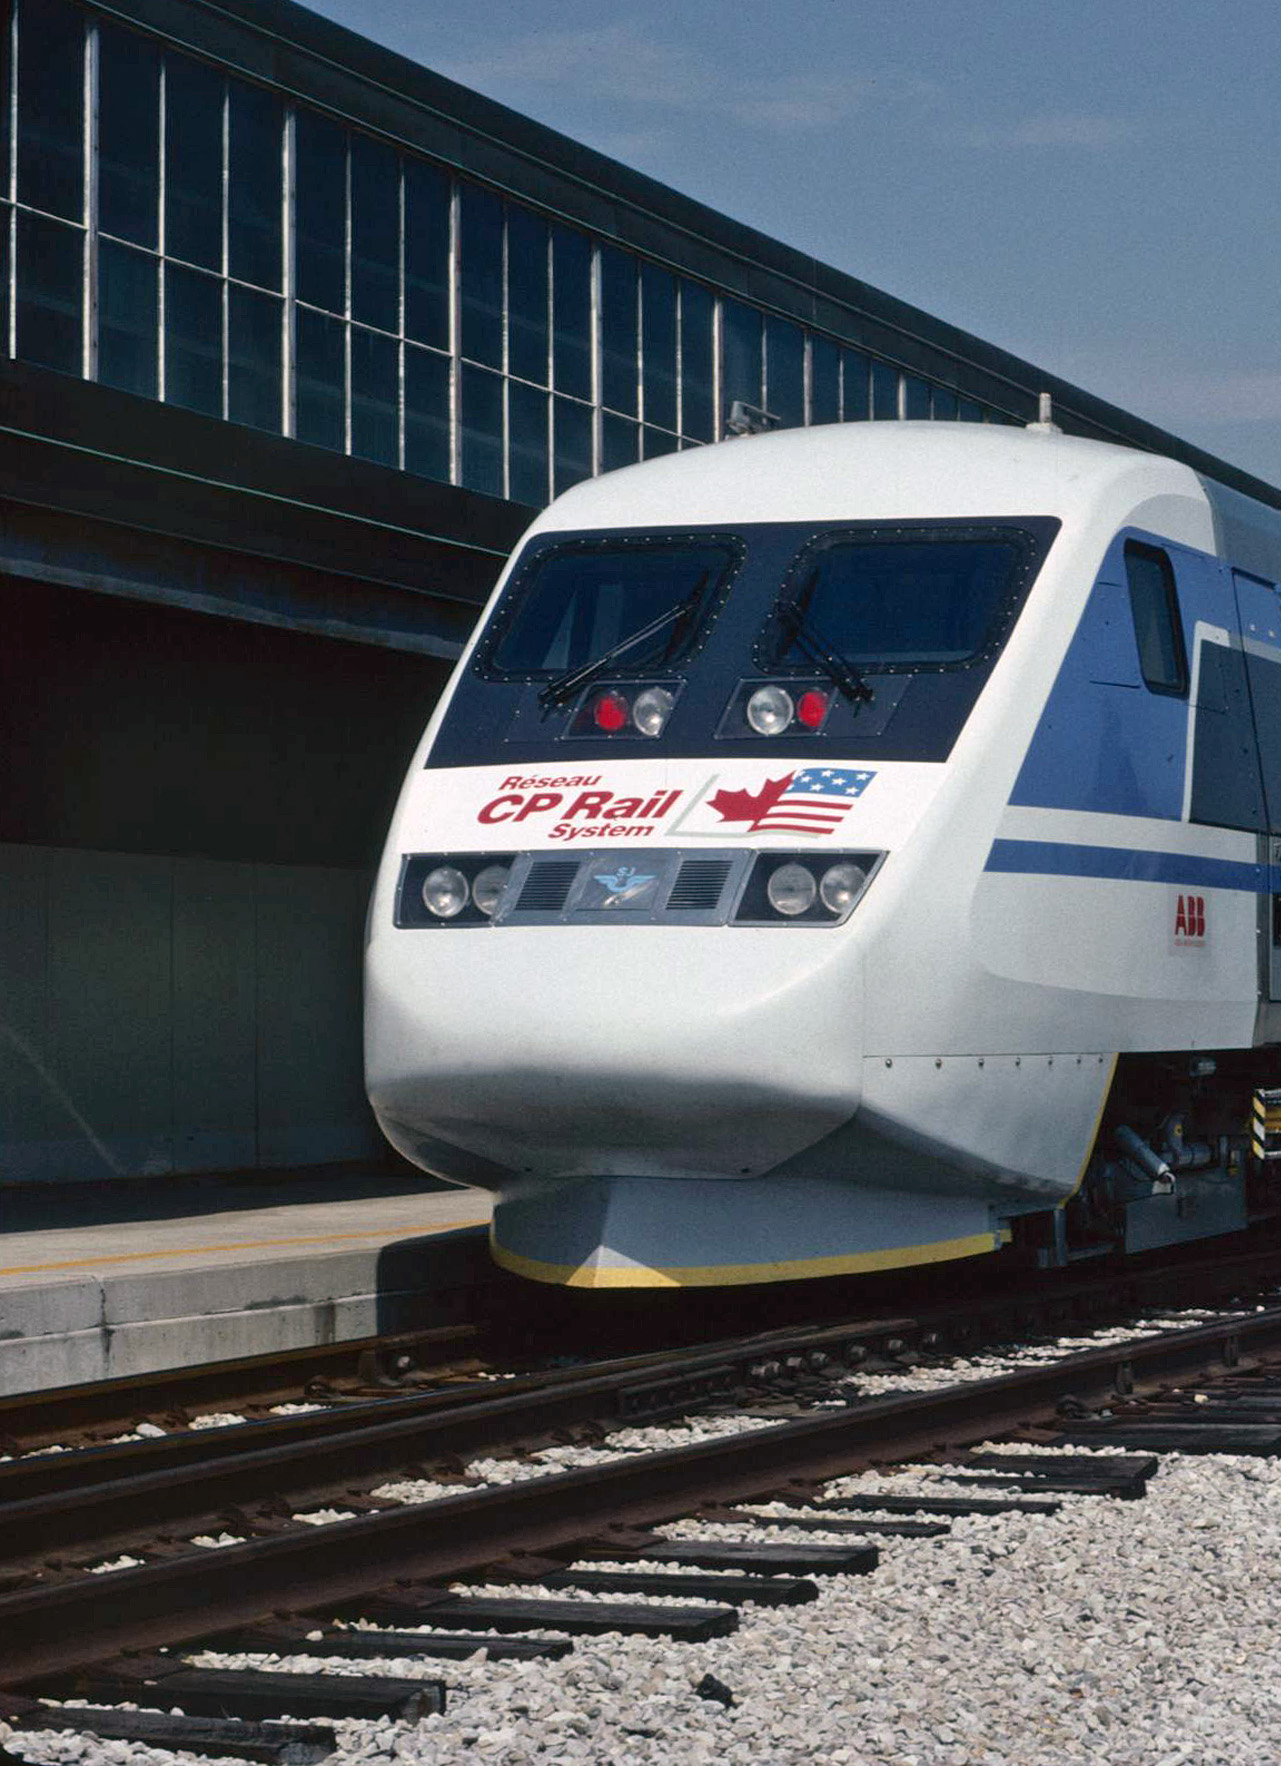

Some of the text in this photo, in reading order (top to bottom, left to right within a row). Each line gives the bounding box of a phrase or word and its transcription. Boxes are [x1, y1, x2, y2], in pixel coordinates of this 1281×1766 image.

[499, 774, 603, 791] Réseau
[476, 789, 684, 825] CP Rail
[547, 822, 655, 842] System
[1174, 894, 1206, 937] ABB
